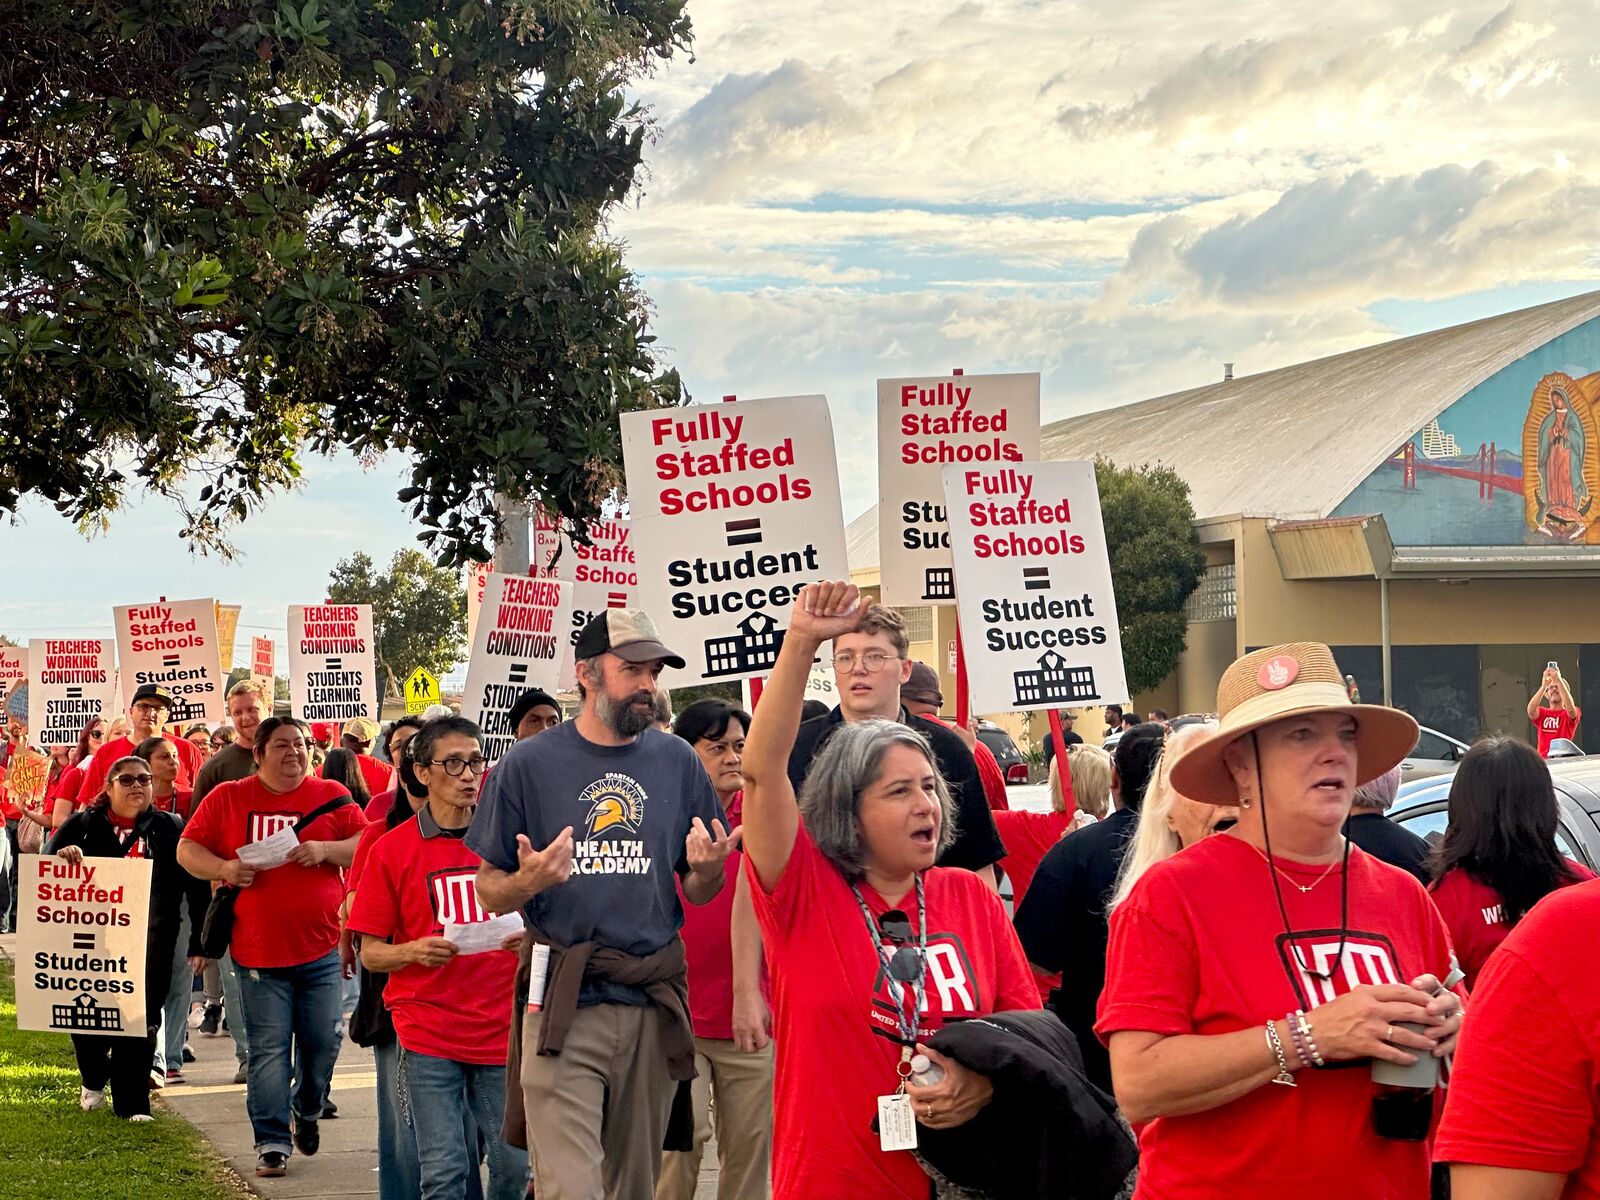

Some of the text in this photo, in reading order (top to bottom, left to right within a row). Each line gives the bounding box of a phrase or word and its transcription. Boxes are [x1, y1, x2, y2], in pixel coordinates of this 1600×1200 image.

[901, 383, 971, 410] Fully
[652, 411, 743, 446] Fully
[901, 409, 1007, 436] Staffed
[655, 438, 795, 480] Staffed
[901, 438, 1018, 464] Schools
[965, 469, 1033, 499] Fully
[660, 474, 812, 515] Schools
[970, 498, 1071, 527] Staffed
[592, 522, 630, 545] ully
[973, 529, 1086, 558] Schools
[577, 543, 635, 563] Staffe
[575, 566, 638, 585] Schoo
[668, 544, 818, 587] Student
[502, 578, 560, 607] TEACHERS
[128, 606, 171, 622] Fully
[303, 607, 359, 622] TEACHERS
[982, 594, 1094, 623] Student
[130, 618, 195, 637] Staffed
[497, 605, 553, 633] WORKING
[304, 623, 356, 638] WORKING
[986, 625, 1107, 652] Success
[45, 640, 102, 655] TEACHERS
[131, 635, 204, 652] Schools
[300, 639, 365, 655] CONDITIONS
[486, 631, 556, 660] CONDITIONS
[46, 655, 98, 670] WORKING
[41, 670, 106, 684] CONDITIONS
[136, 666, 207, 684] Student
[307, 671, 362, 688] STUDENTS
[307, 687, 360, 703] LEARNING
[47, 700, 102, 714] STUDENTS
[303, 703, 367, 720] CONDITIONS
[40, 730, 80, 744] CONDIT
[605, 772, 635, 785] SPARTAN
[575, 840, 644, 858] HEALTH
[38, 860, 96, 883] Fully
[570, 857, 652, 875] ACADEMY
[37, 883, 124, 903] Staffed
[36, 905, 131, 926] Schools
[35, 952, 127, 973] Student
[34, 972, 135, 994] Success
